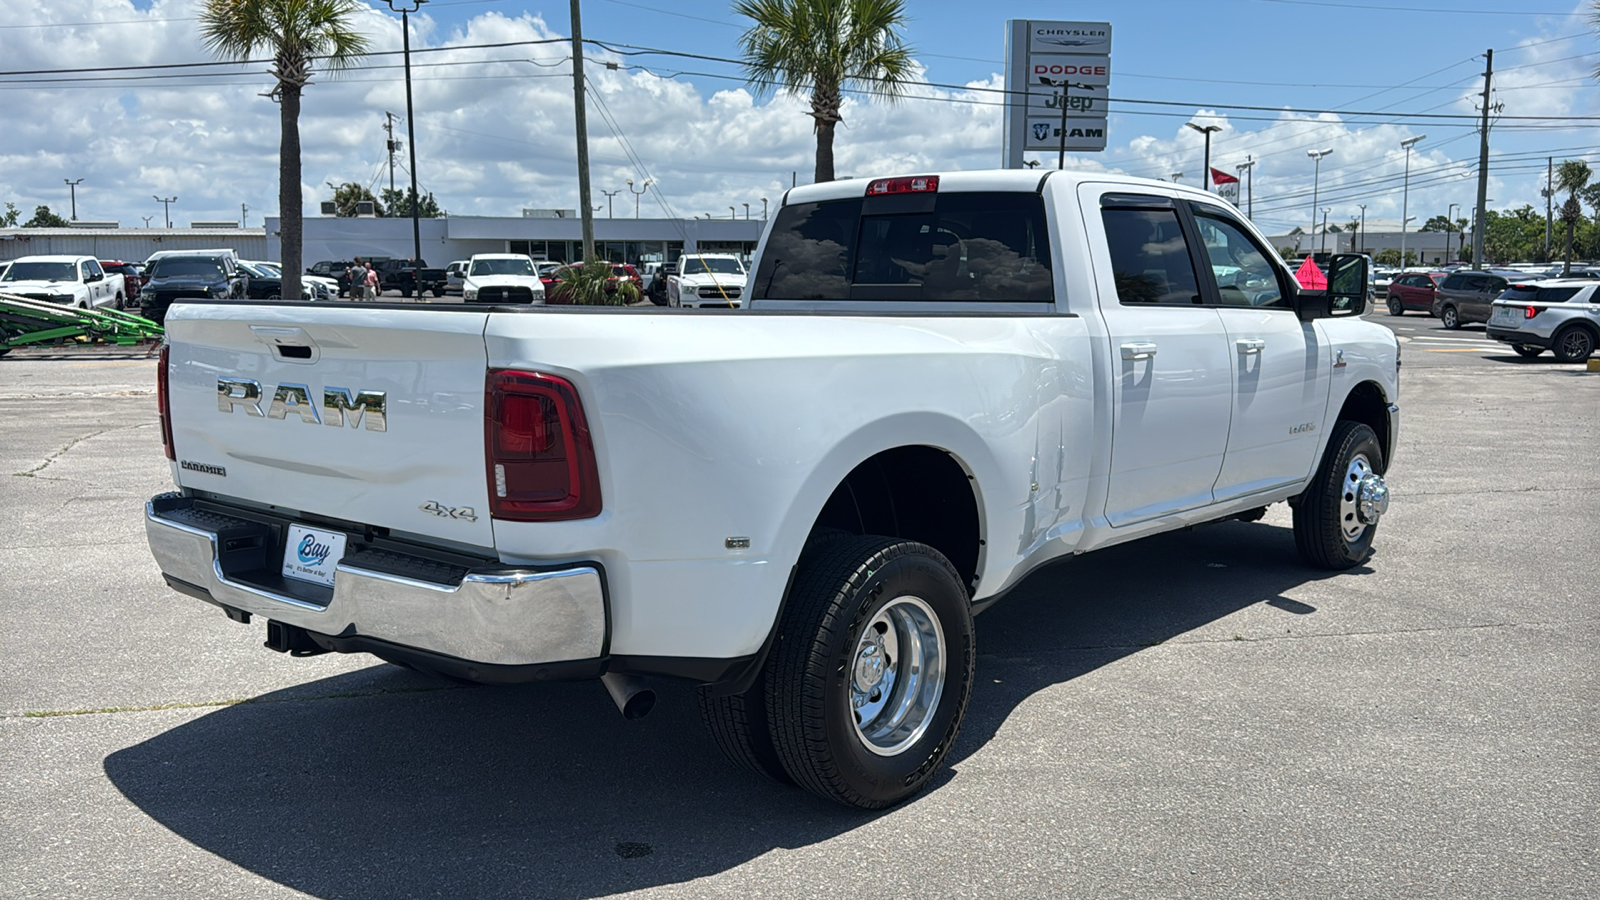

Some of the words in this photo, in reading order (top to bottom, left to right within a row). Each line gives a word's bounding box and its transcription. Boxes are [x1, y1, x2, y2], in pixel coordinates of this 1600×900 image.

[1037, 29, 1105, 37] CHRYSLER
[1034, 65, 1107, 75] DODGE
[1045, 90, 1093, 112] Jeep
[1053, 128, 1103, 138] RAM
[217, 375, 388, 432] RAM
[180, 459, 227, 477] LARAMIE
[300, 534, 330, 565] Bay
[836, 580, 884, 679] NEXEN
